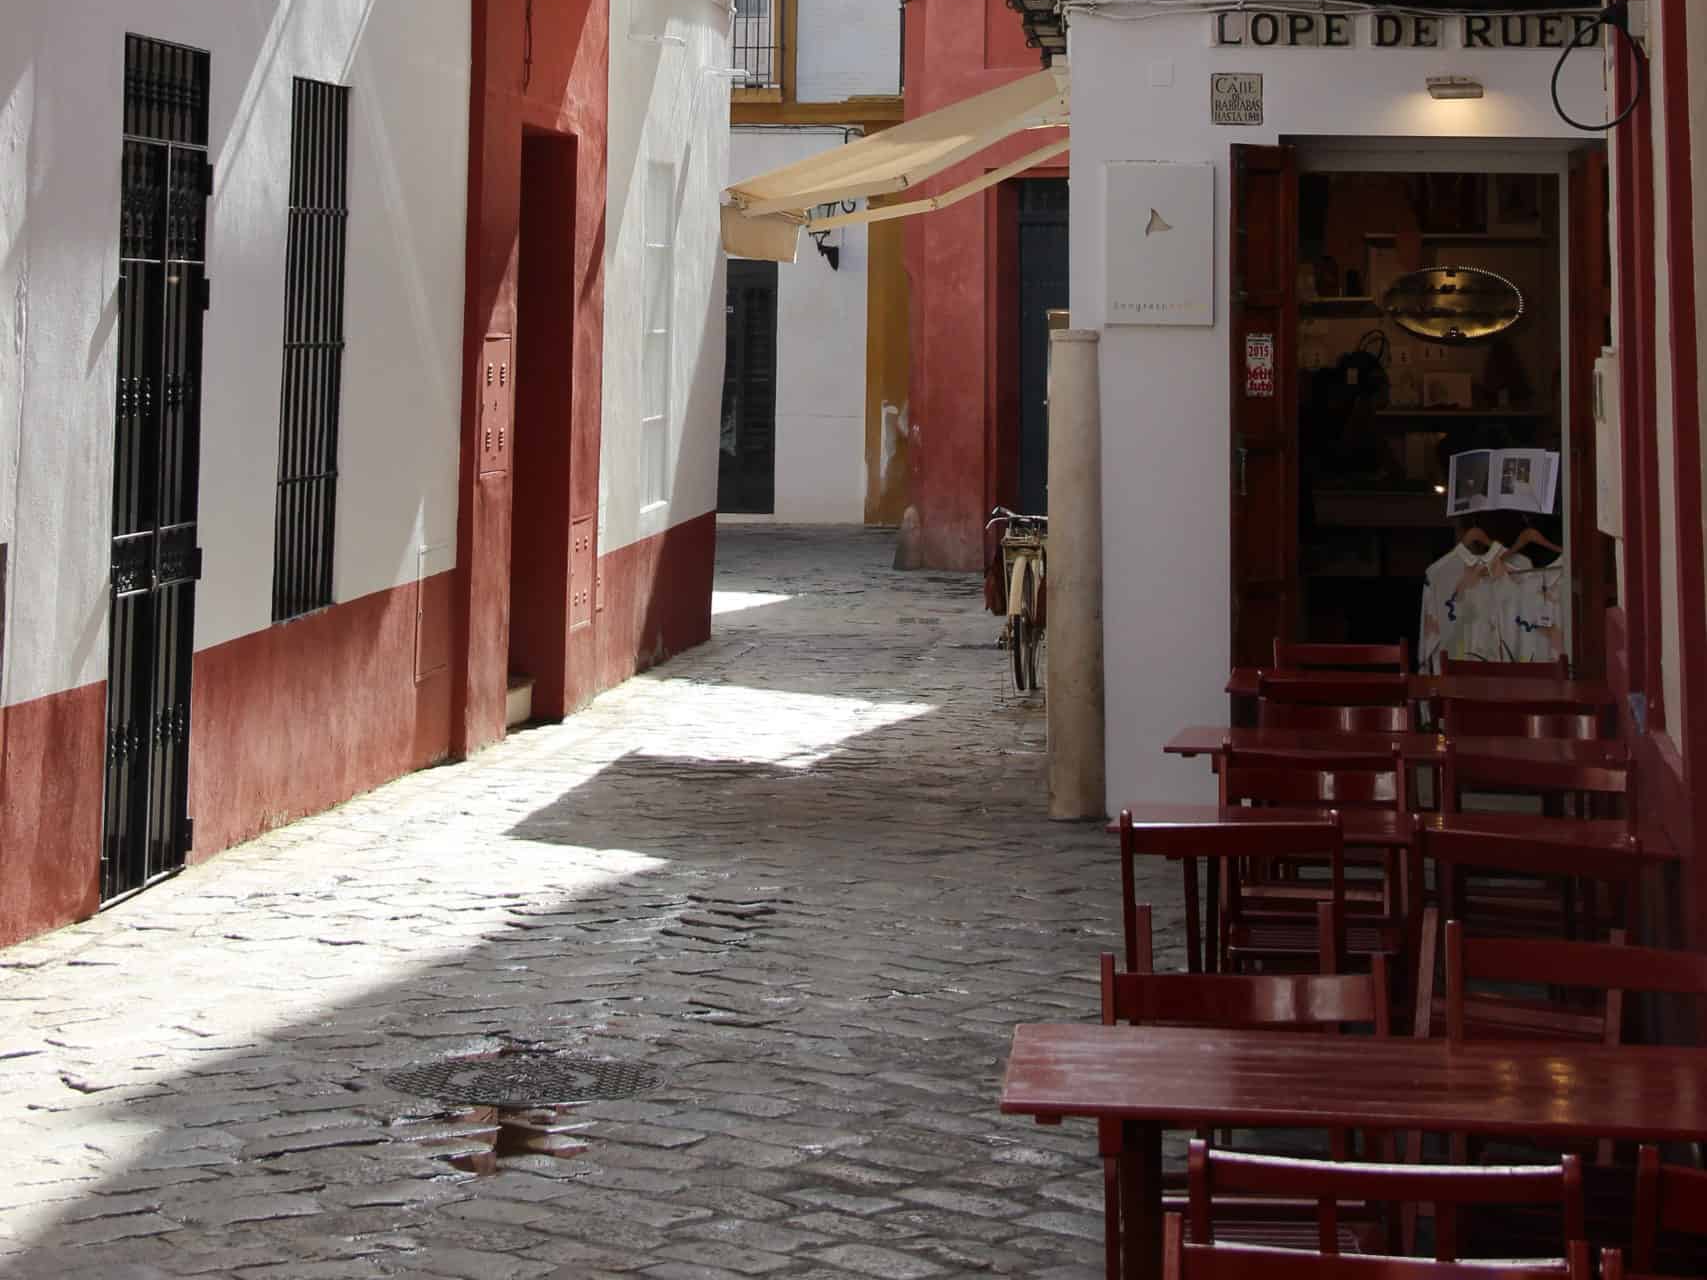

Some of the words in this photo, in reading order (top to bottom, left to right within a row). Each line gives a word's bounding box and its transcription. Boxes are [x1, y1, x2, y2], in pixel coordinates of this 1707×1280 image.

[1216, 13, 1350, 46] LOPE
[1374, 14, 1438, 48] DE
[1247, 344, 1269, 357] 2015
